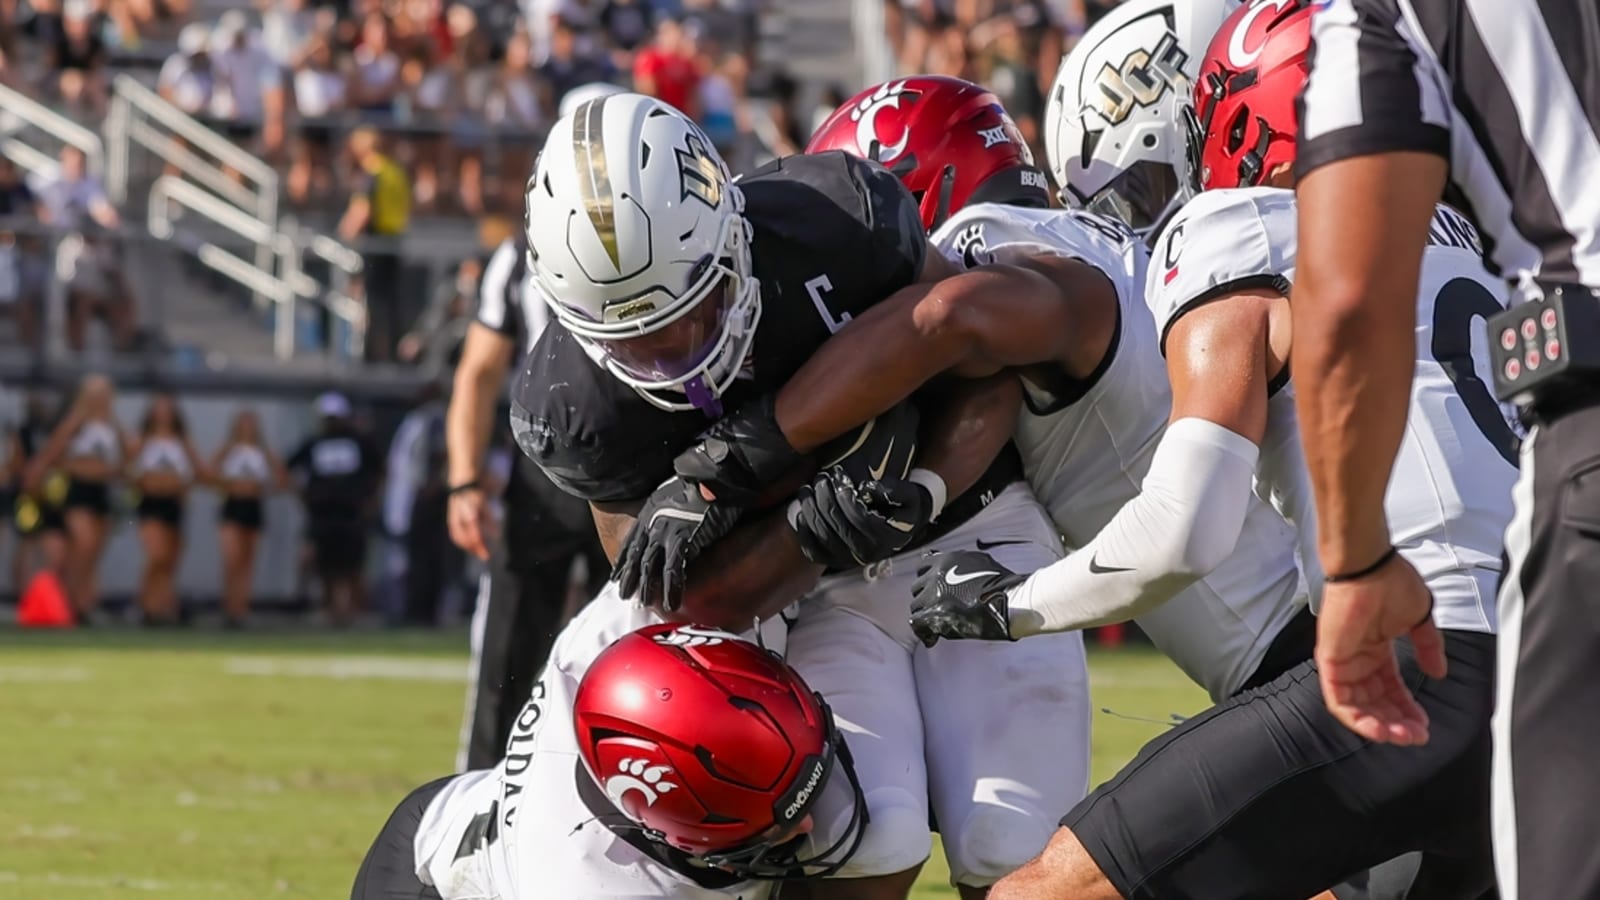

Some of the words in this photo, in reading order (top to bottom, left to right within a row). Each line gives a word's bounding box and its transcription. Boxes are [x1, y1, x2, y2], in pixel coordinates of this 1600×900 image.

[1094, 31, 1189, 127] UCF
[804, 273, 853, 334] C
[784, 761, 824, 820] CINCINNATI
